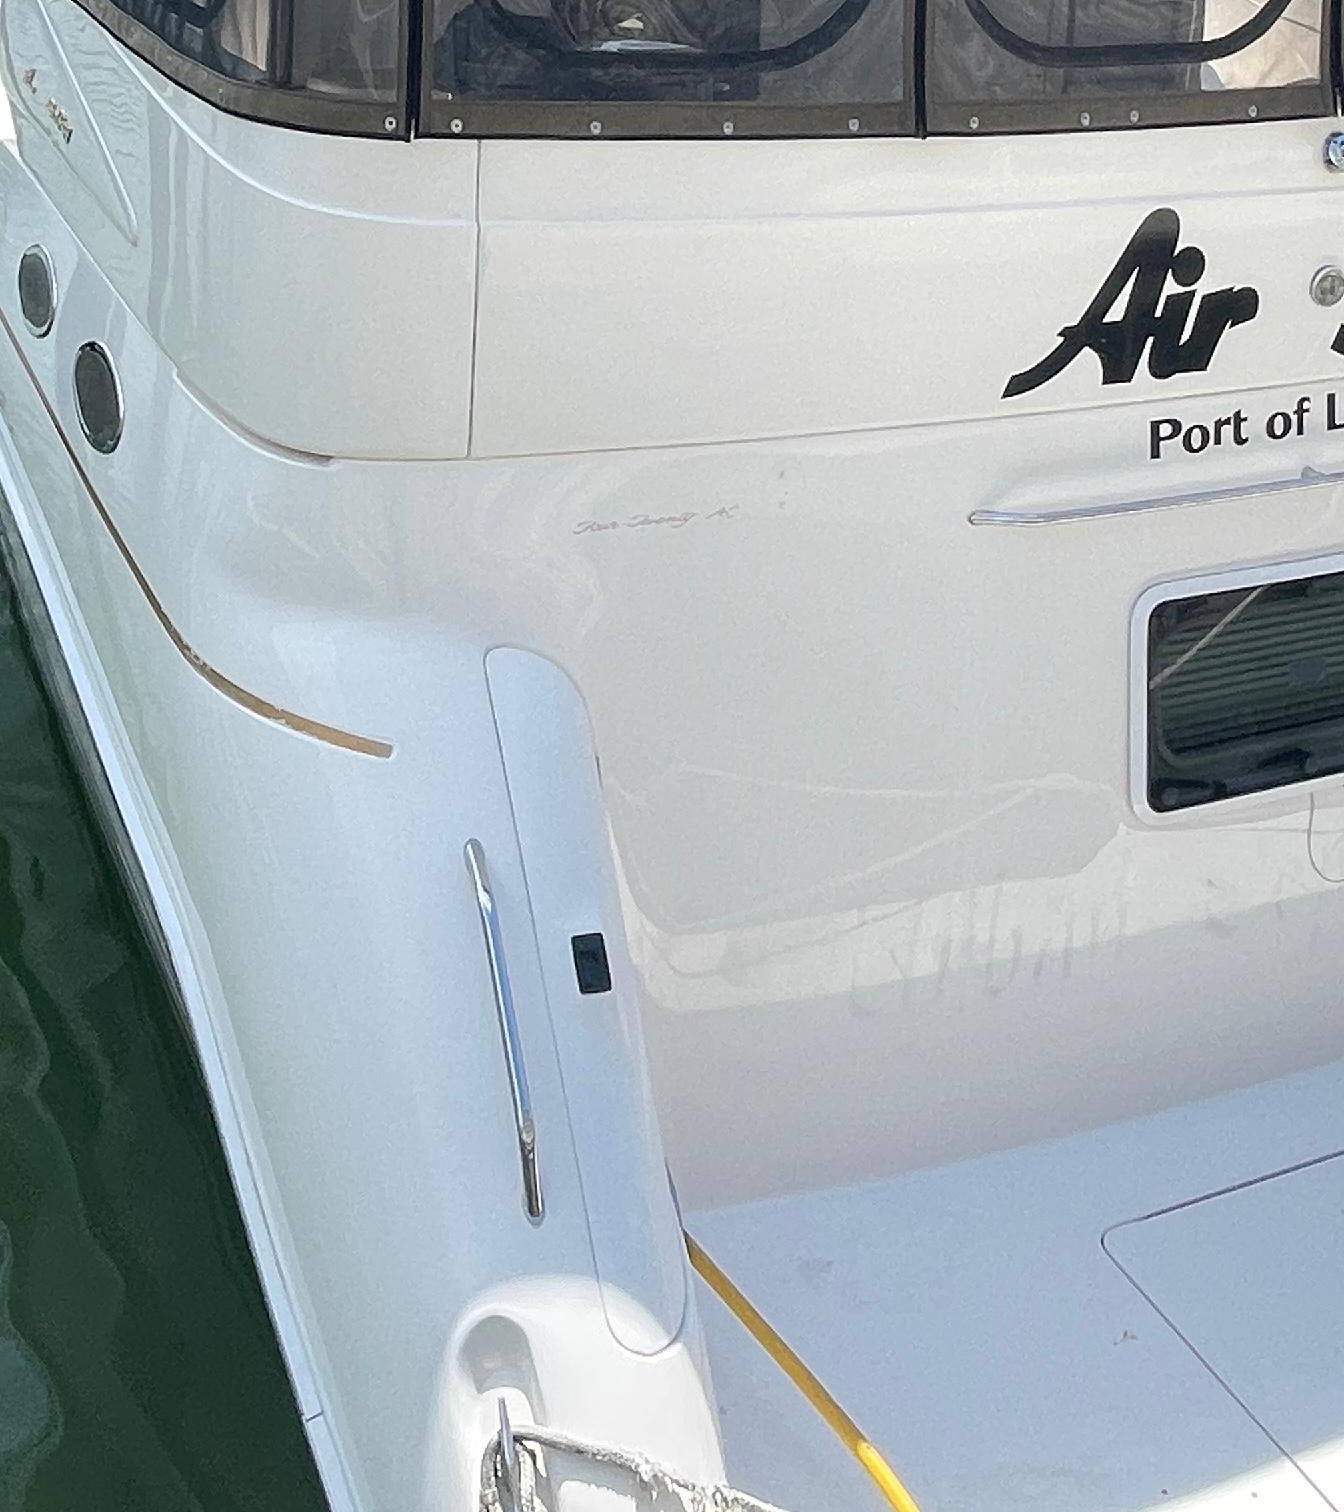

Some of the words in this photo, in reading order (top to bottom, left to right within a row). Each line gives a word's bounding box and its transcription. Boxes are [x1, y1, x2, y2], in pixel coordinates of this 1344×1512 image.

[1001, 208, 1259, 399] Air
[1150, 410, 1249, 459] Port
[1267, 397, 1311, 440] of
